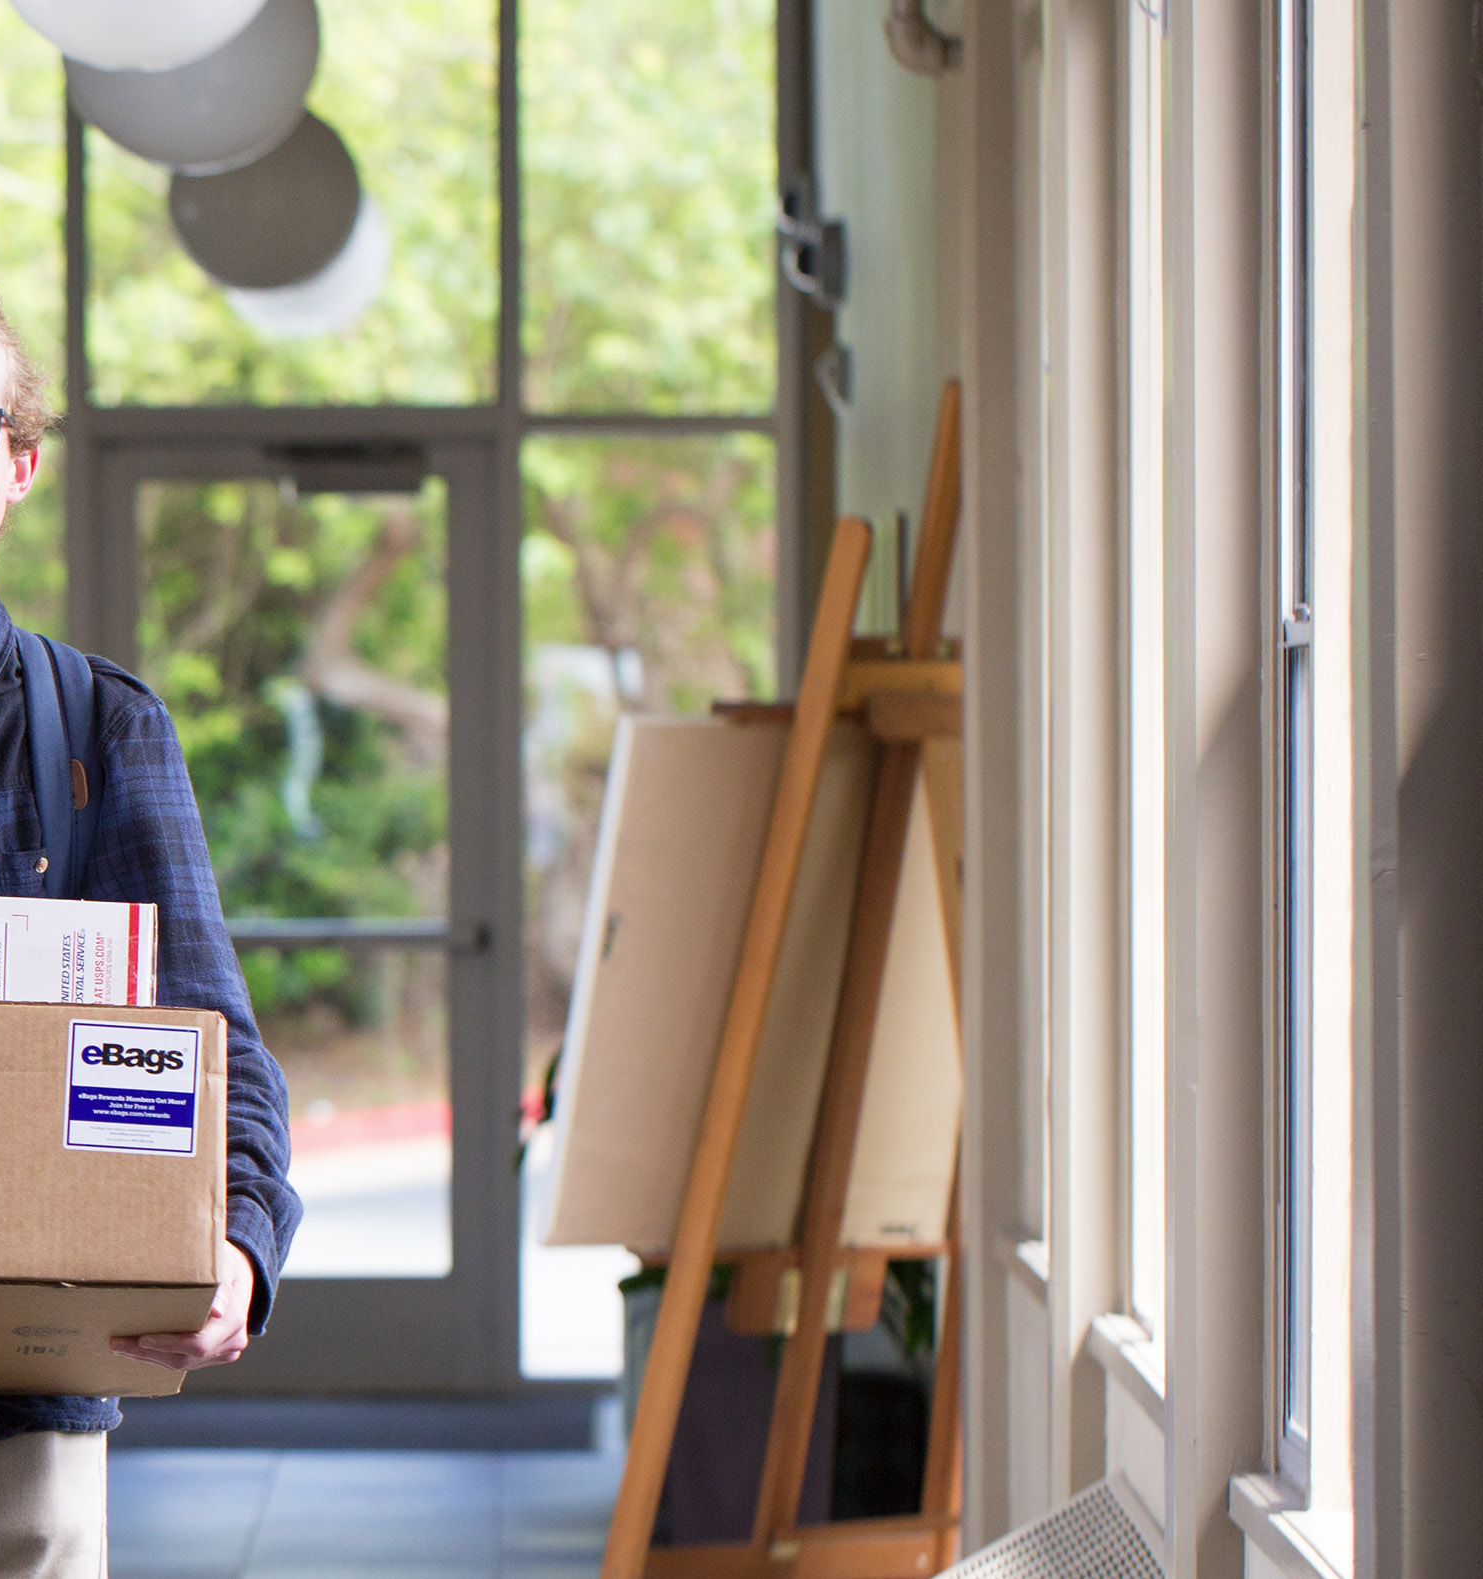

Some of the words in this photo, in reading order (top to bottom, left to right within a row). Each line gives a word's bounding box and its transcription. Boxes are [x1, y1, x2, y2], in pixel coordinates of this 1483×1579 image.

[61, 934, 71, 970] STATES
[105, 937, 113, 963] ONLINE
[61, 971, 70, 1002] NITED
[75, 975, 84, 1003] OSTAL
[94, 987, 103, 999] AT
[104, 964, 112, 996] SUPPLIES
[81, 1042, 184, 1075] eBags
[98, 1093, 125, 1102] Rewards
[126, 1095, 155, 1104] Members
